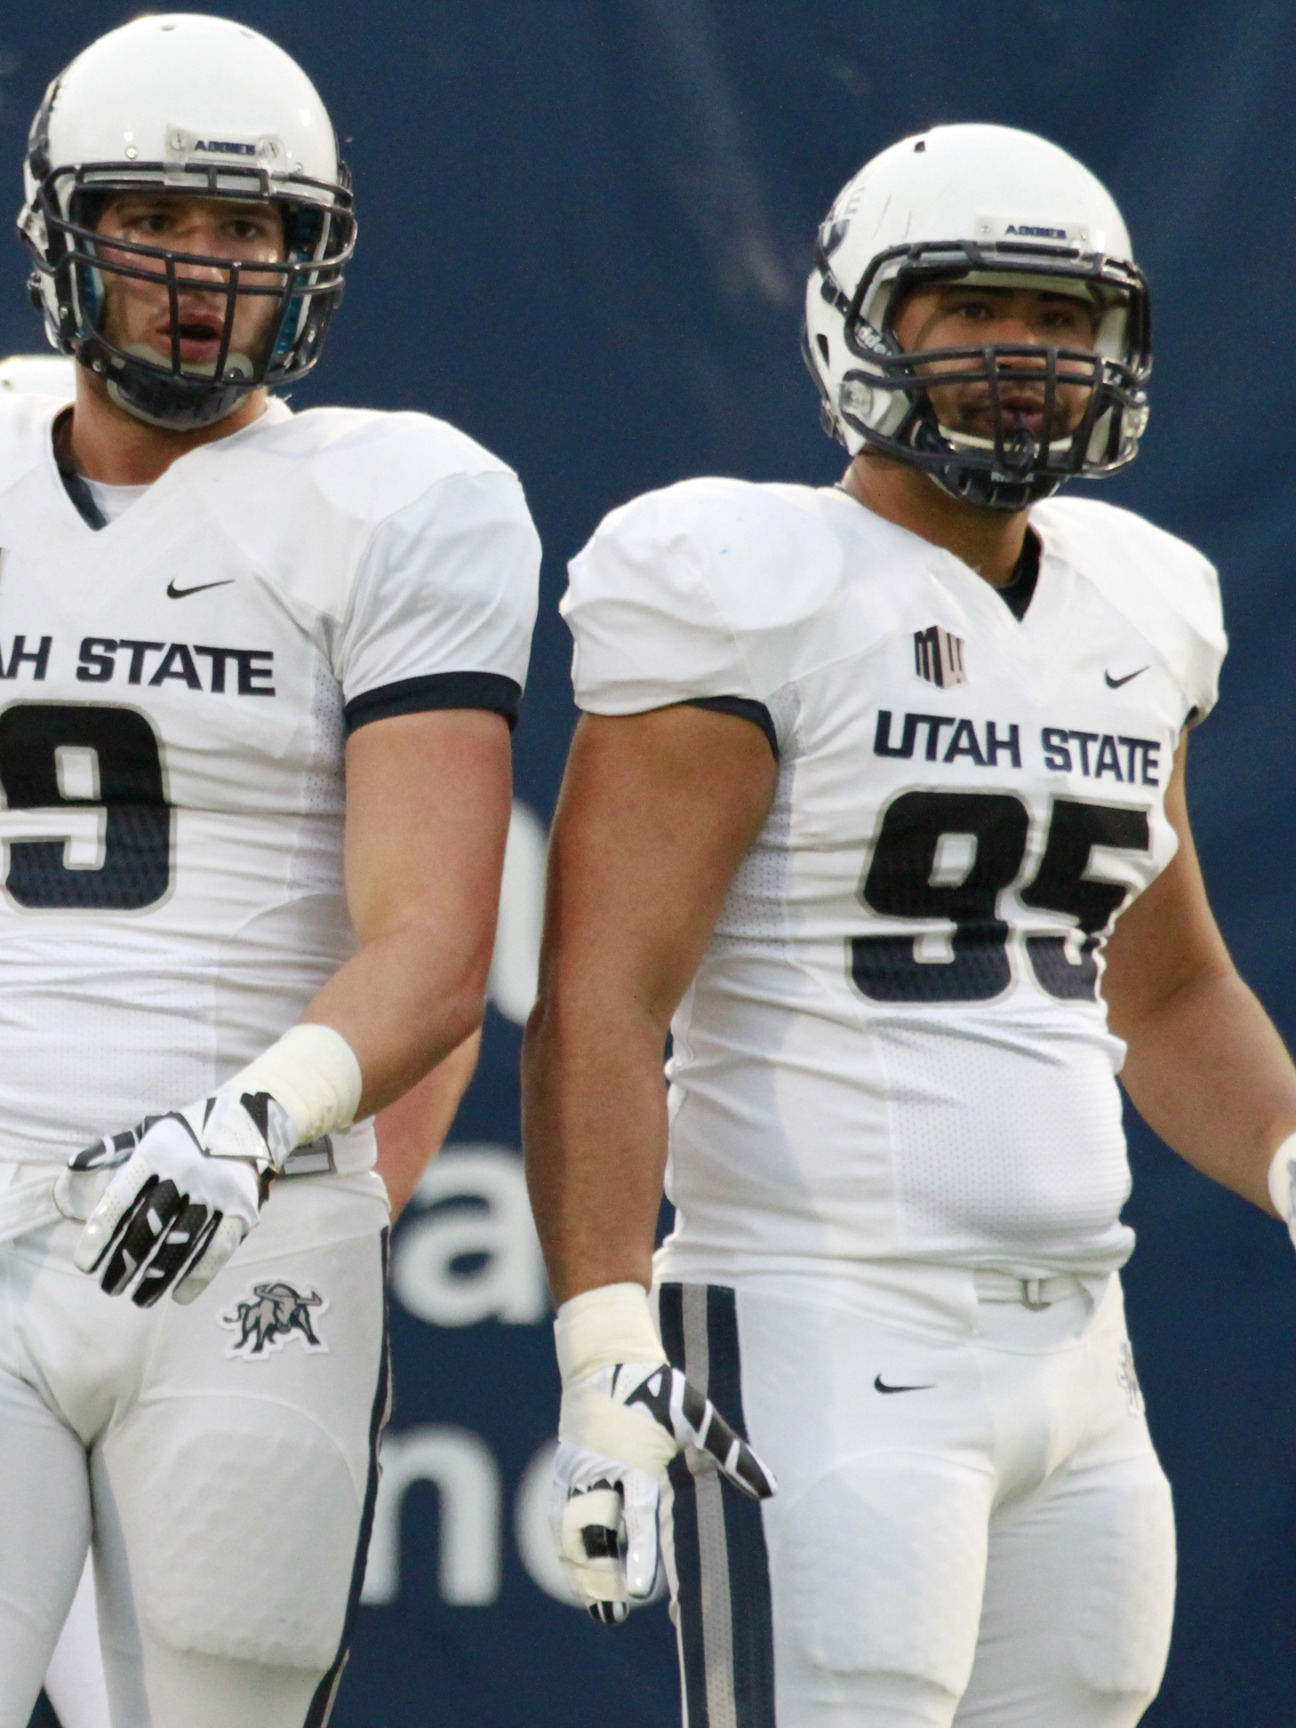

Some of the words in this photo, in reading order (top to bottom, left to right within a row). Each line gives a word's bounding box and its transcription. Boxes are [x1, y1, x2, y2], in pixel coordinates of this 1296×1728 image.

[75, 636, 277, 697] STATE
[873, 709, 1023, 769] UTAH
[1040, 727, 1162, 788] STATE
[844, 783, 1155, 1006] 95
